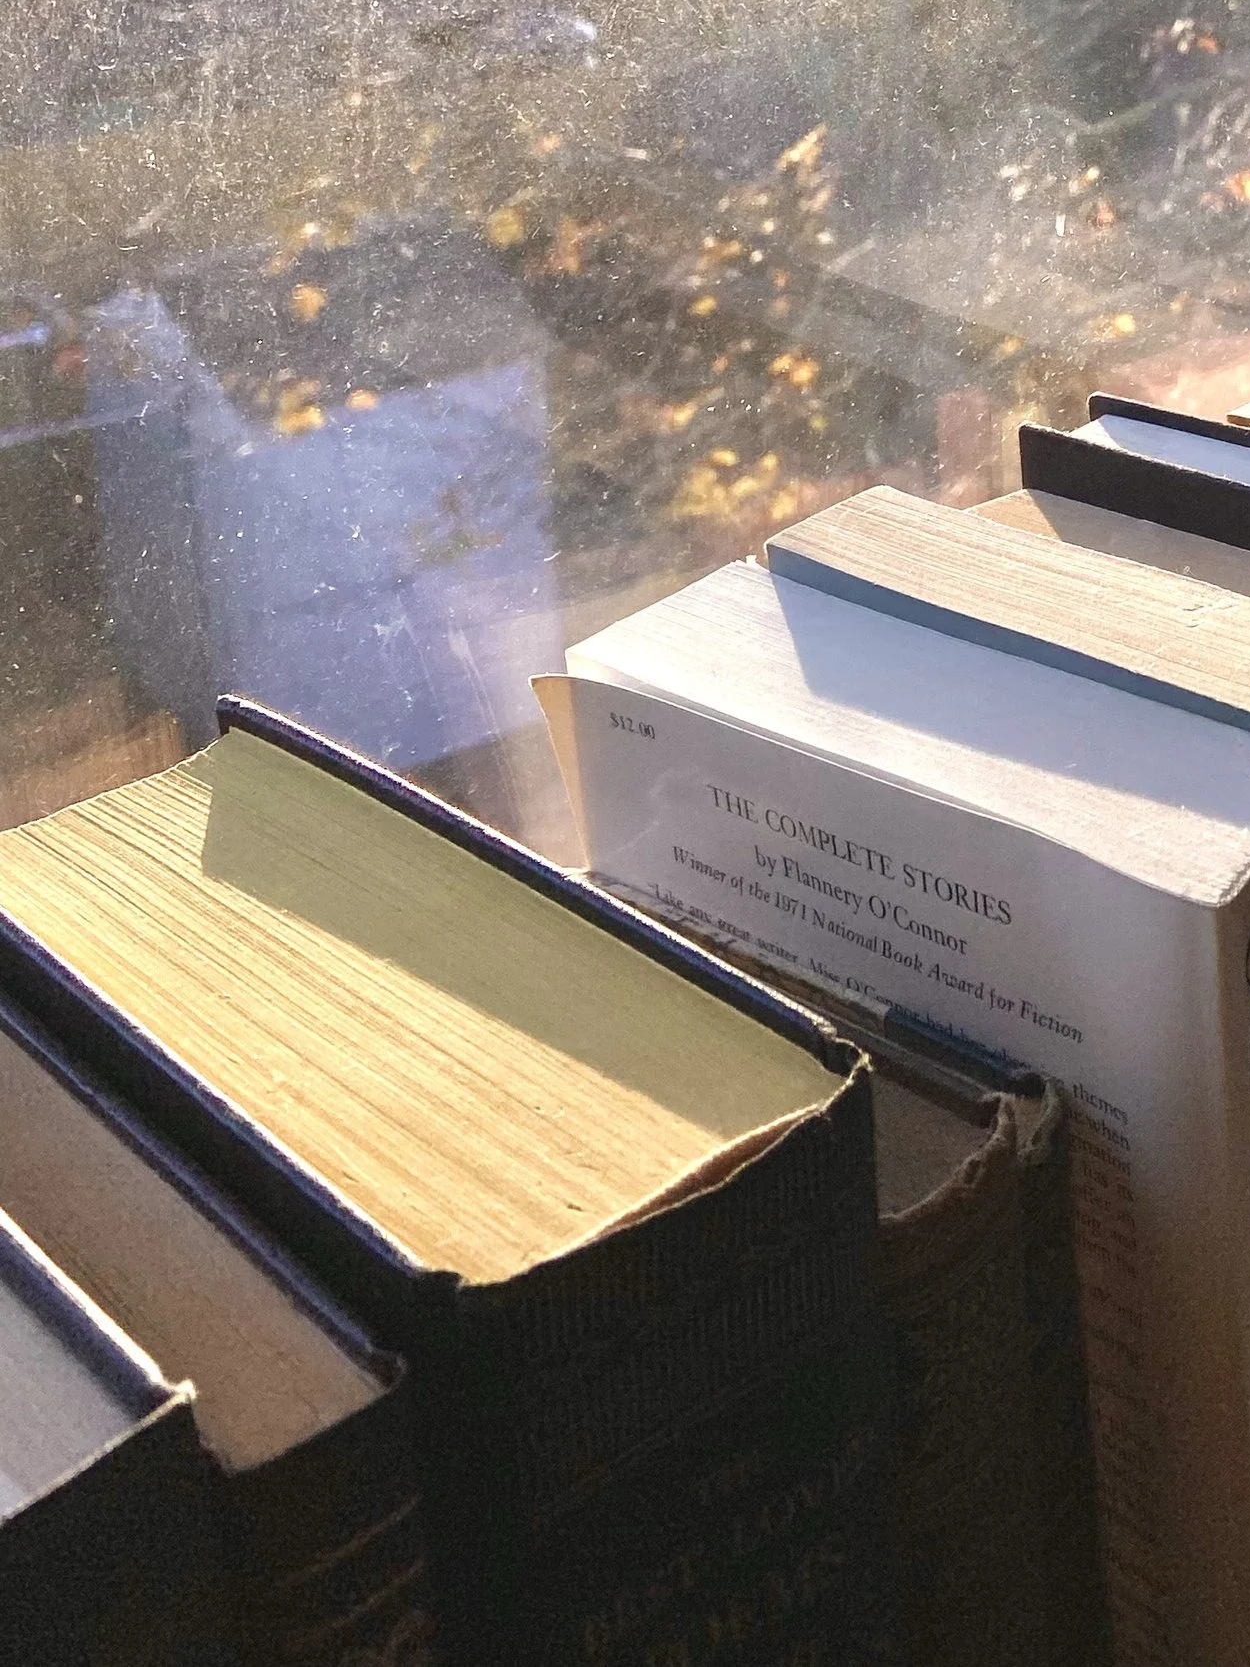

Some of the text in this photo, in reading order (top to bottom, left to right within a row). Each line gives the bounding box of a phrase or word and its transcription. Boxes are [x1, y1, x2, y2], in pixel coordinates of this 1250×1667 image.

[608, 711, 656, 740] $12.00
[706, 784, 1013, 926] THE COMPLETE STORIES
[754, 845, 969, 956] by Flannery O'Connor
[671, 844, 1085, 1044] Winner of the 1971 National Book Award for Fiction
[1072, 1082, 1129, 1126] themes
